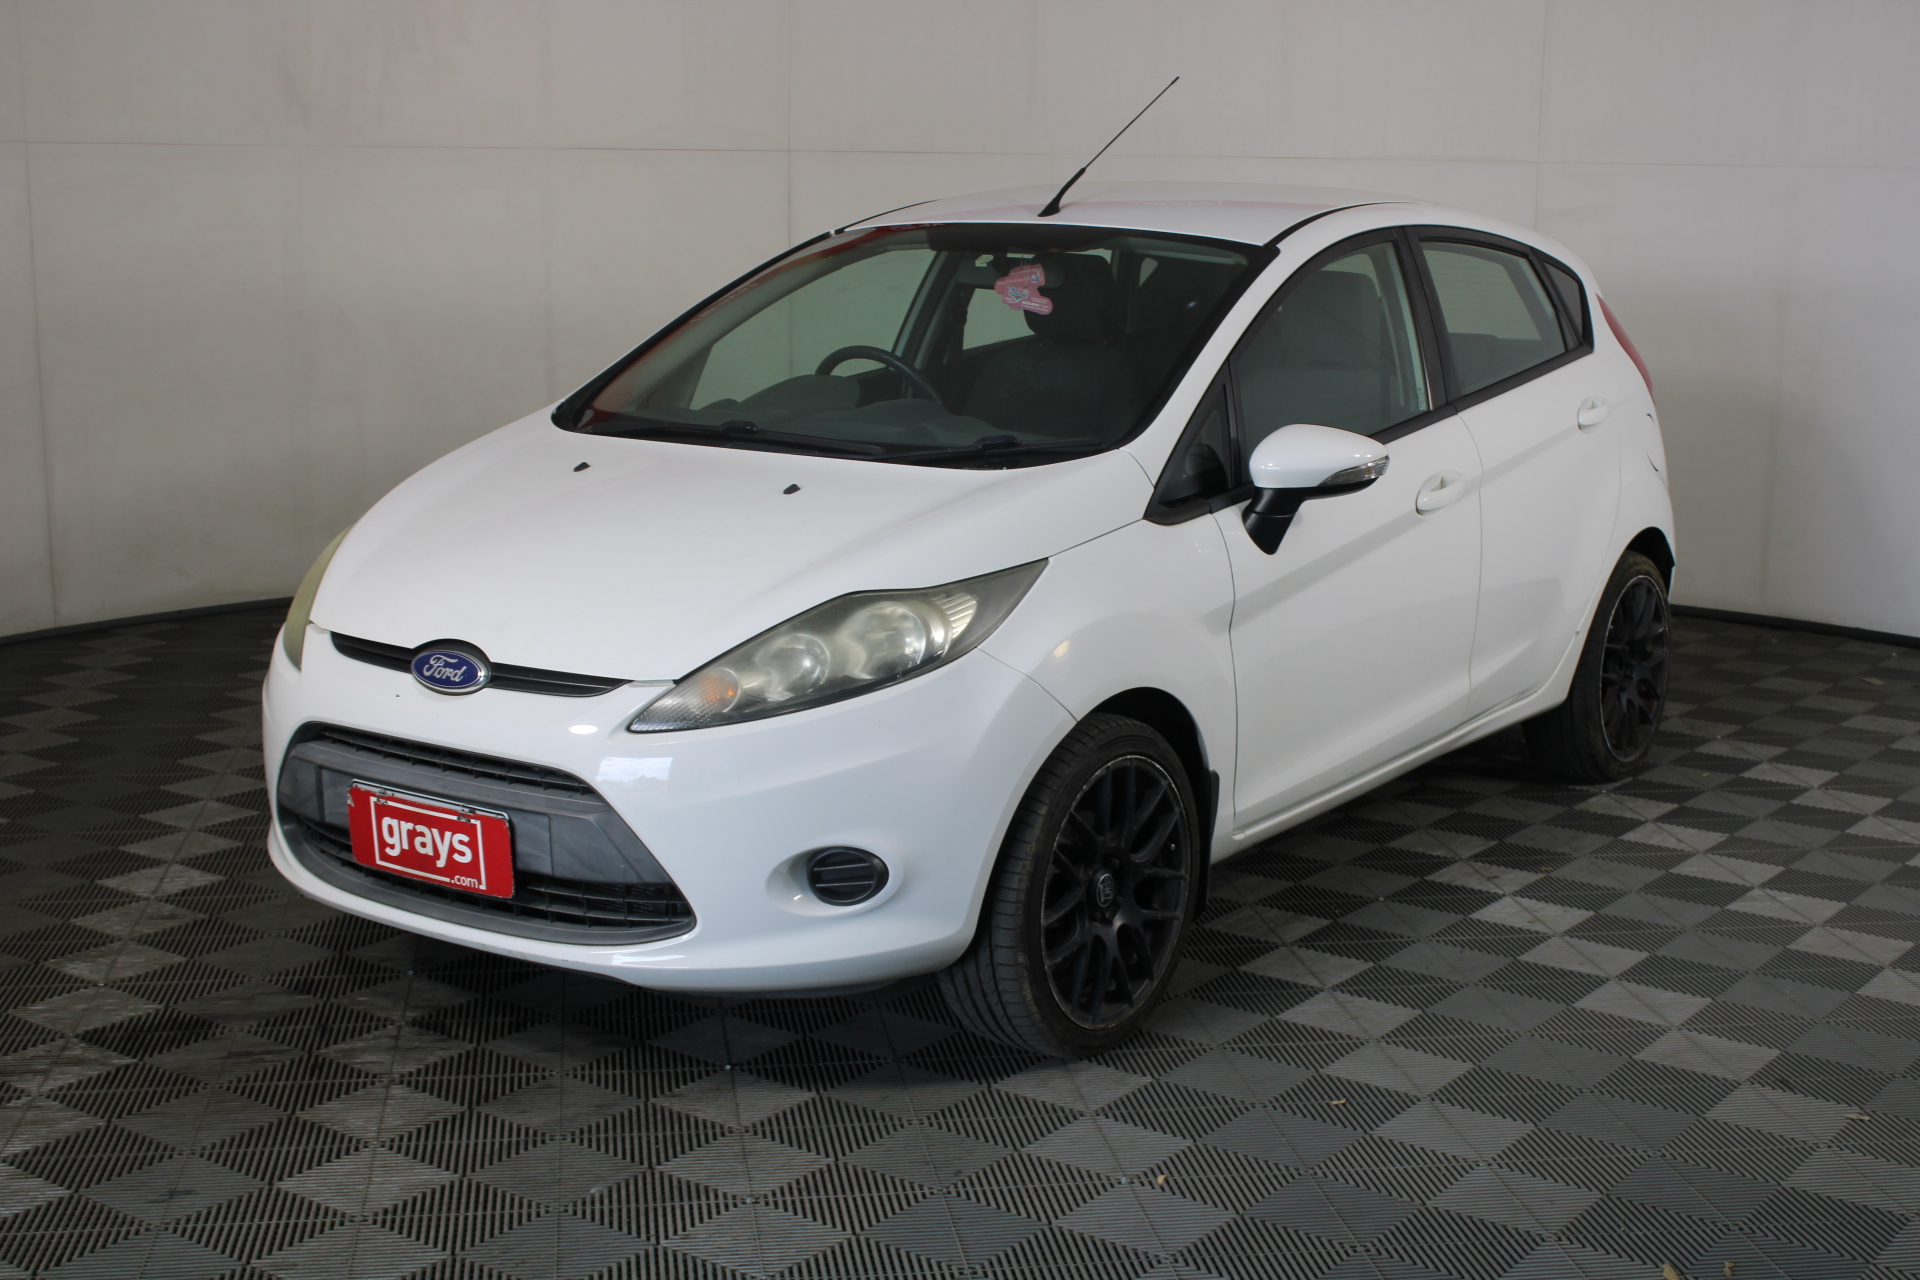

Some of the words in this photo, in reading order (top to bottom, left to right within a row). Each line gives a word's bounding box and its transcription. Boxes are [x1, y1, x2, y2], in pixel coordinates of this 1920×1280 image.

[423, 654, 467, 682] Ford
[381, 816, 473, 868] grays
[450, 875, 479, 889] .com
